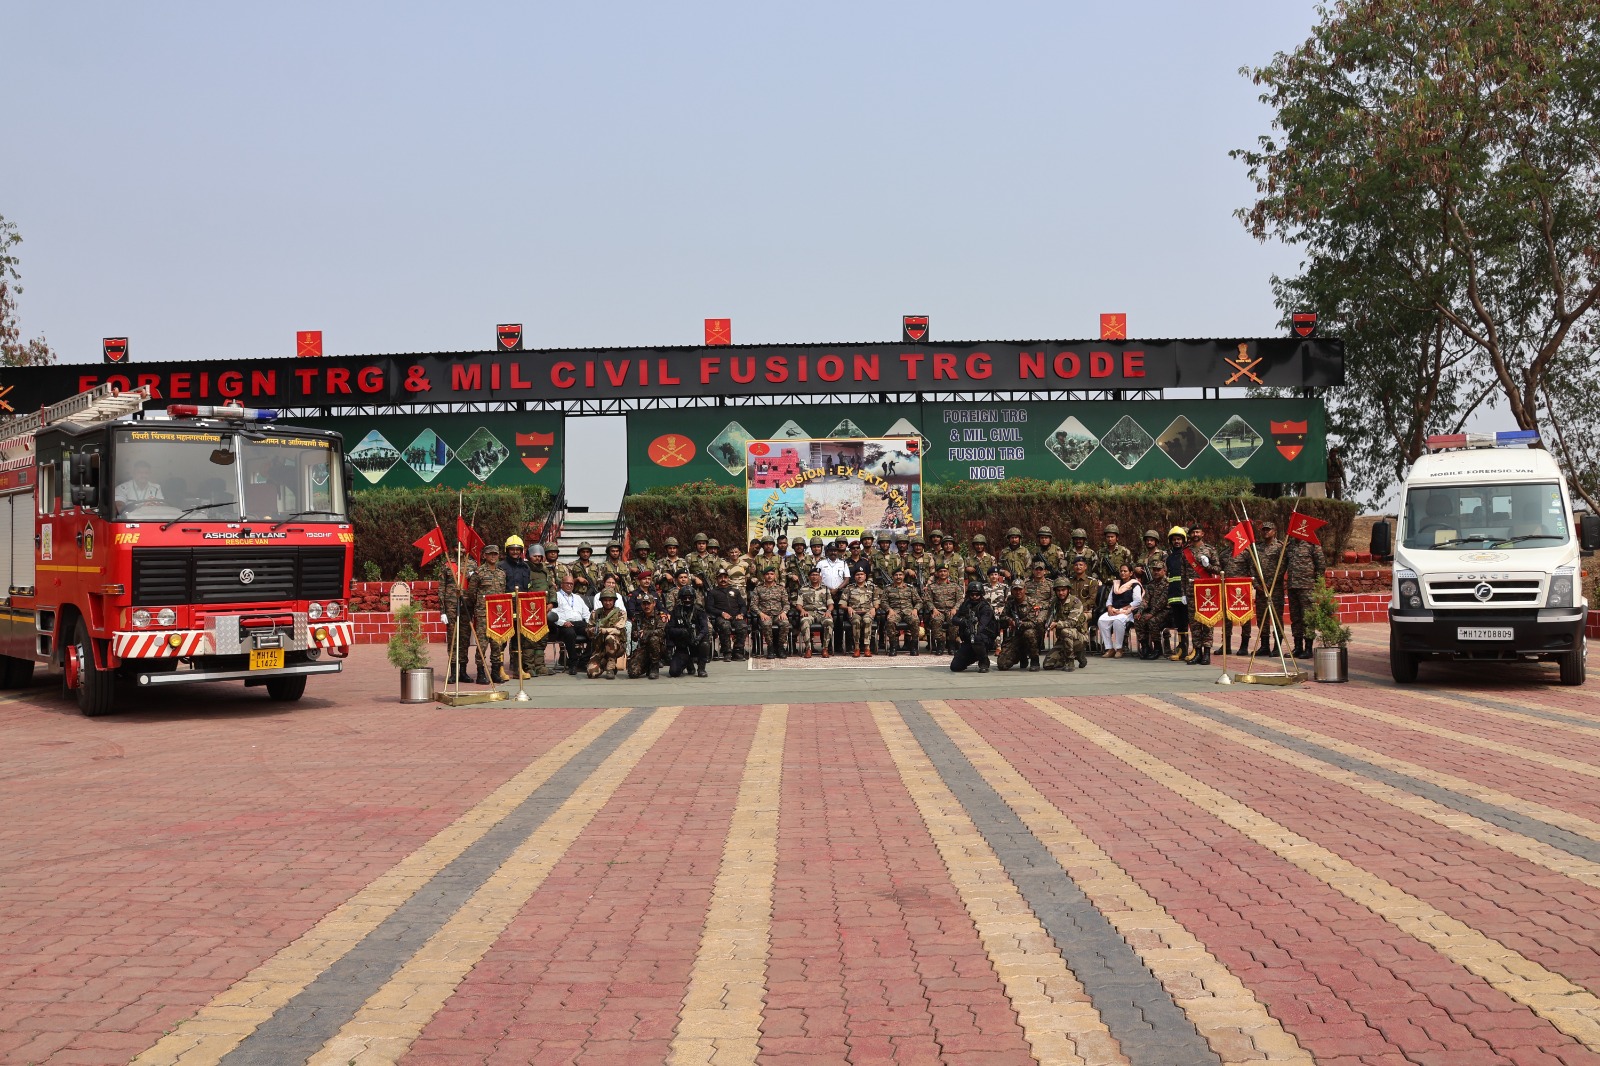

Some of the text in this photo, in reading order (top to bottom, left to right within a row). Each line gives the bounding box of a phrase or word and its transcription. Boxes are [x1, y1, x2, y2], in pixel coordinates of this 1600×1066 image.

[78, 351, 1146, 399] FOREIGN TRG & MIL CIVIL FUSION TRG NODE
[943, 408, 1028, 423] FOREIGN TRG
[950, 428, 1023, 442] & MIL CIVIL
[948, 446, 1025, 461] FUSION TRG
[969, 465, 1005, 480] NODE
[1430, 470, 1463, 478] MOBILE
[762, 490, 780, 513] CIV
[780, 466, 826, 495] FUSION
[837, 465, 855, 477] EX
[857, 468, 890, 493] EKTA
[889, 489, 917, 537] SHAKTI
[115, 533, 140, 544] FIRE
[811, 528, 860, 537] 30 JAN 2026
